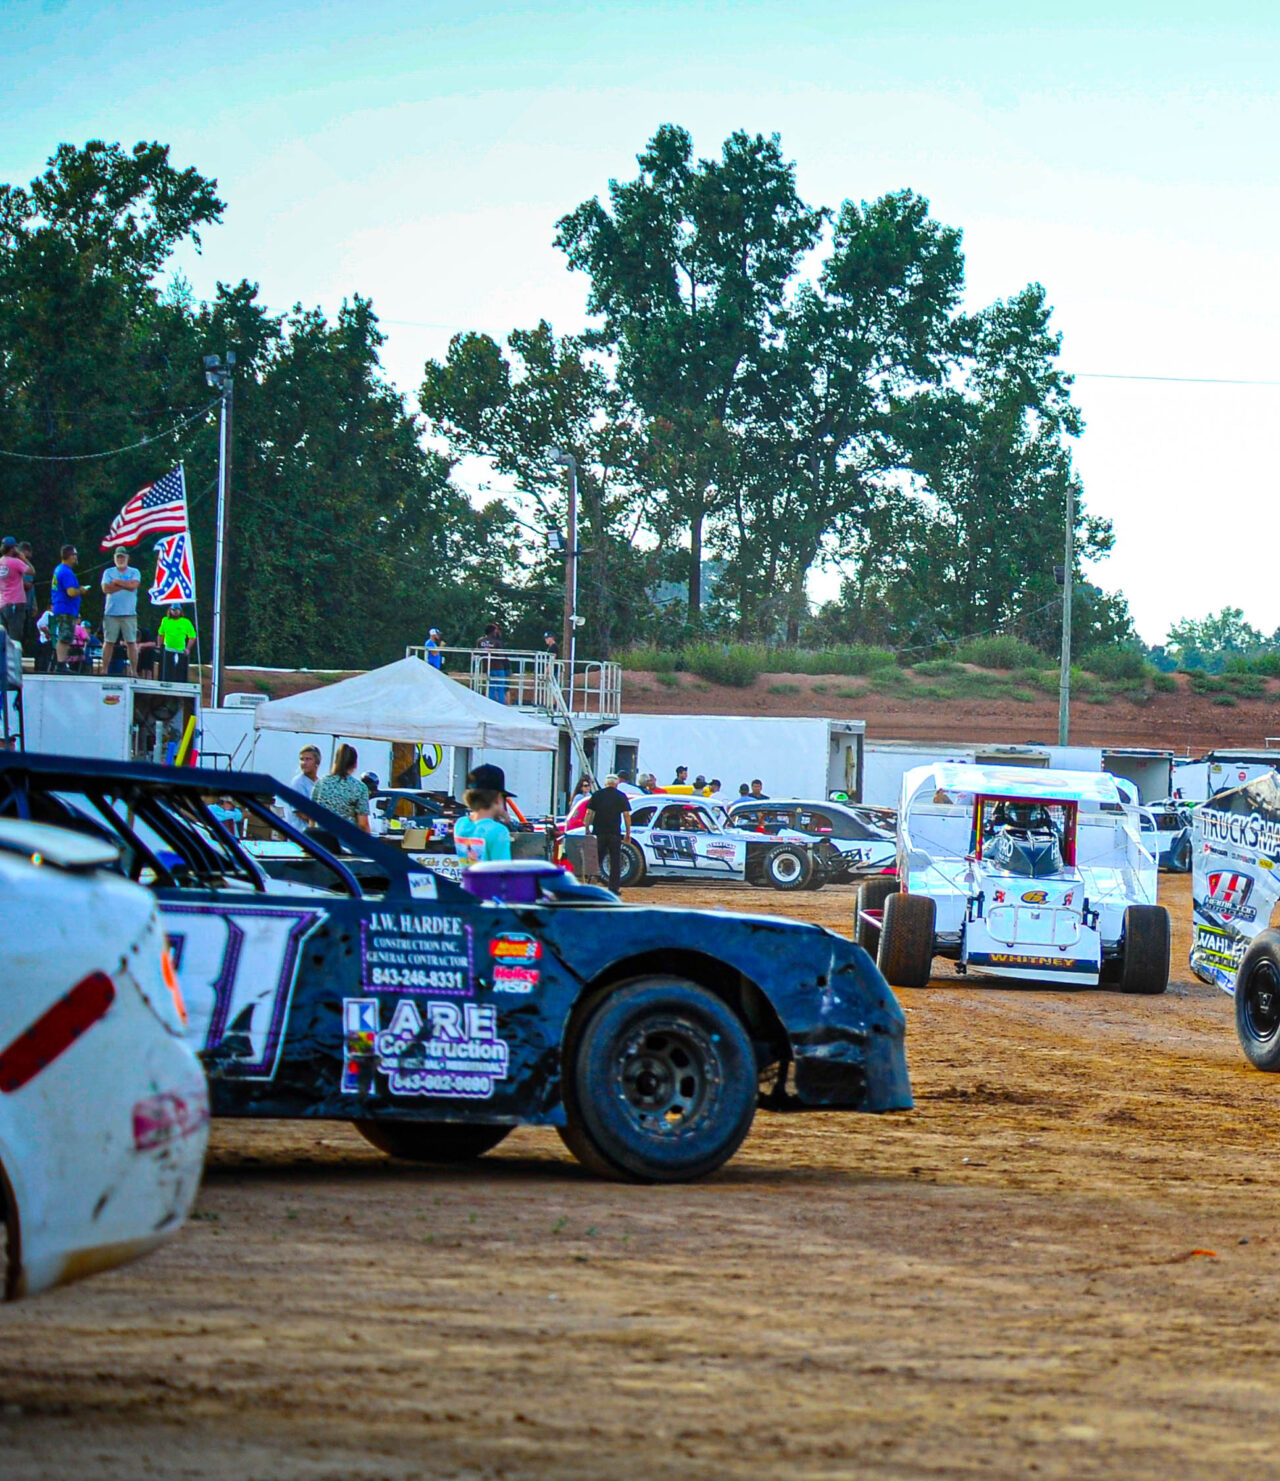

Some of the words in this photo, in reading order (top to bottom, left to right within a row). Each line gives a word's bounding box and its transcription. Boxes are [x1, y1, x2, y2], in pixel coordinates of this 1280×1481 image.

[369, 913, 397, 932] J.W.
[400, 915, 463, 936] HARDEE
[373, 936, 440, 953] CONSTRUCTION
[366, 951, 407, 965] GENERAL
[408, 953, 469, 968] CONTRACTOR
[990, 953, 1075, 967] WHITNEY
[371, 967, 464, 989] 843-246-8331
[492, 980, 533, 993] MSD
[379, 1035, 506, 1061] Cotruction
